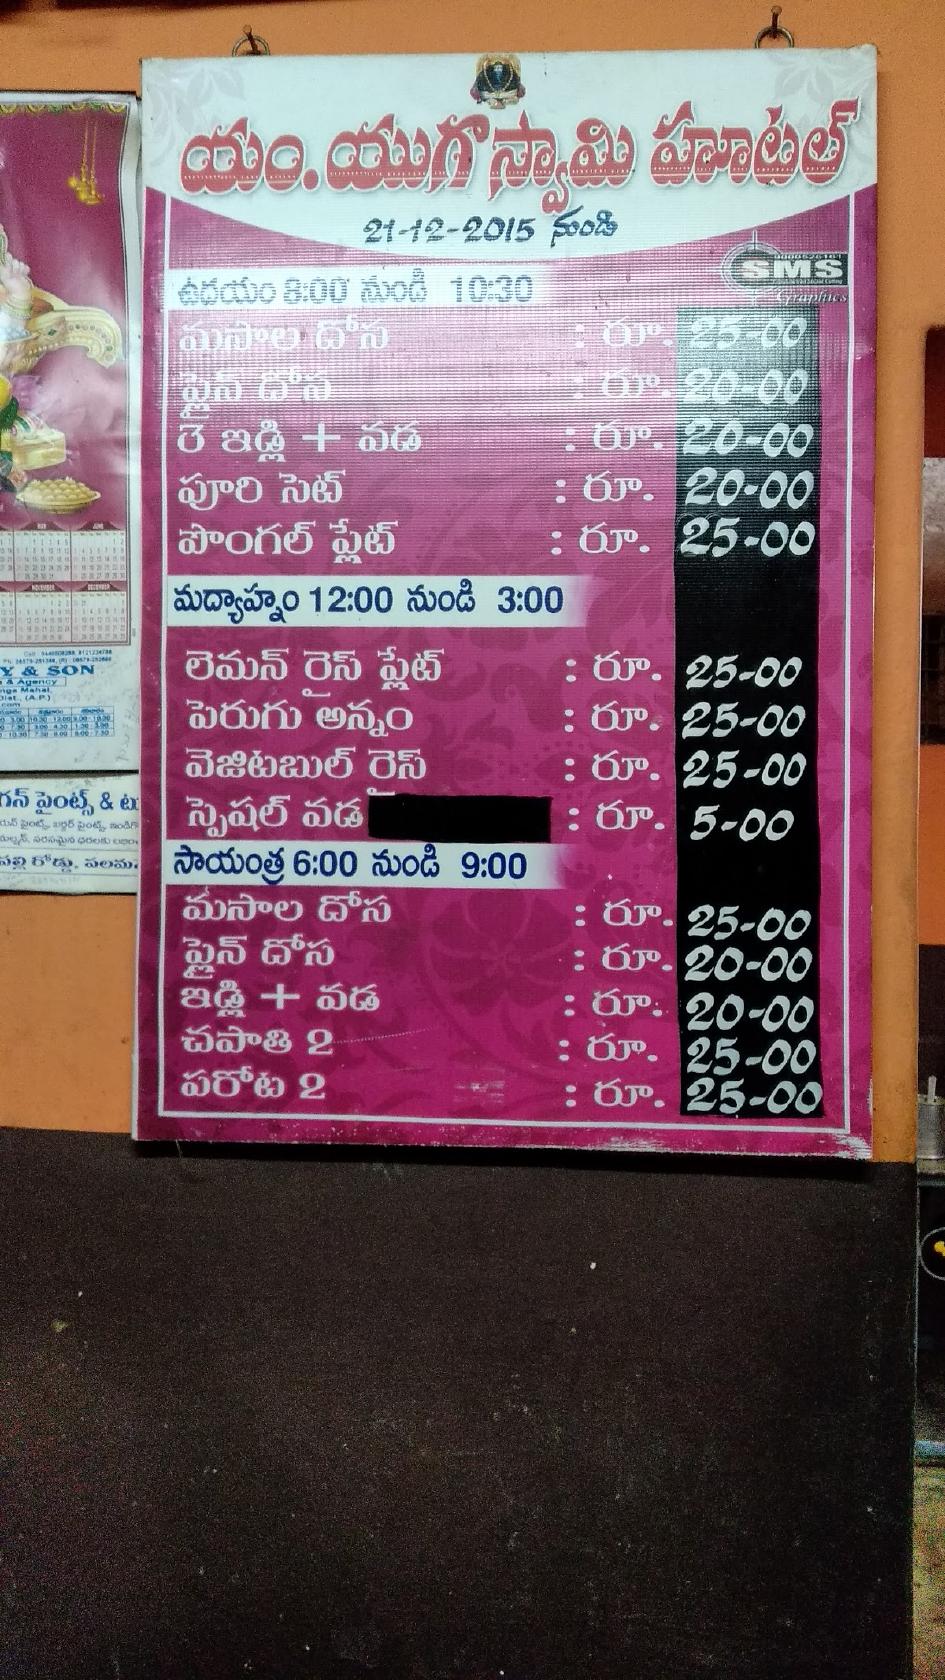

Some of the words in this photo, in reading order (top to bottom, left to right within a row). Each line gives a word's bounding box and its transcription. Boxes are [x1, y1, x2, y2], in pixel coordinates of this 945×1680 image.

[363, 215, 536, 243] 21-12-2015
[550, 205, 618, 247] నుండి
[283, 276, 348, 305] 8:00
[361, 268, 428, 303] నుండి
[450, 275, 533, 303] 10:30
[742, 259, 843, 278] SMS
[690, 316, 808, 349] 25-00
[682, 367, 809, 405] 20-00
[221, 419, 287, 463] ఇడ్లి
[358, 420, 422, 452] వడ
[682, 418, 815, 457] 20-00
[177, 472, 263, 511] పూరి
[278, 470, 346, 503] సెట్
[684, 467, 815, 509] 20-00
[178, 520, 316, 555] పొంగల్
[329, 518, 399, 564] ప్లేట్
[680, 517, 816, 557] 25-00
[173, 582, 300, 624] మద్యాహ్నం
[309, 585, 394, 614] 12:00
[406, 578, 477, 614] నుండి
[497, 586, 564, 614] 3:00
[17, 679, 58, 687] Agency
[22, 666, 38, 676] &
[47, 665, 95, 676] SON
[185, 647, 289, 681] లెమన్
[301, 648, 362, 698] రైస్
[377, 645, 445, 691] ప్లేట్
[685, 654, 803, 690] 25-00
[186, 698, 303, 731] పెరుగు
[315, 699, 414, 738] అన్నం
[682, 701, 806, 740] 25-00
[185, 747, 357, 779] వెజిటబుల్
[366, 748, 428, 797] రైస్
[682, 750, 807, 789] 25-00
[100, 791, 114, 810] &
[187, 795, 291, 837] స్పెషల్
[302, 796, 364, 829] వడ
[689, 804, 795, 842] 5-00
[173, 844, 285, 886] సాయంత్ర
[293, 850, 358, 878] 6:00
[371, 843, 441, 878] నుండి
[461, 852, 527, 880] 9:00
[182, 892, 303, 923] మసాల
[318, 890, 392, 923] దోస
[687, 903, 812, 941] 25-00
[260, 934, 336, 966] దోస
[684, 944, 813, 983] 20-00
[180, 980, 247, 1018] ఇడ్లి
[316, 982, 381, 1012] వడ
[685, 992, 815, 1033] 20-00
[181, 1025, 293, 1054] చపాతి
[306, 1028, 334, 1055] 2
[686, 1036, 817, 1075] 25-00
[180, 1065, 286, 1098] పరోట
[299, 1072, 326, 1100] 2
[686, 1077, 824, 1115] 25-00
